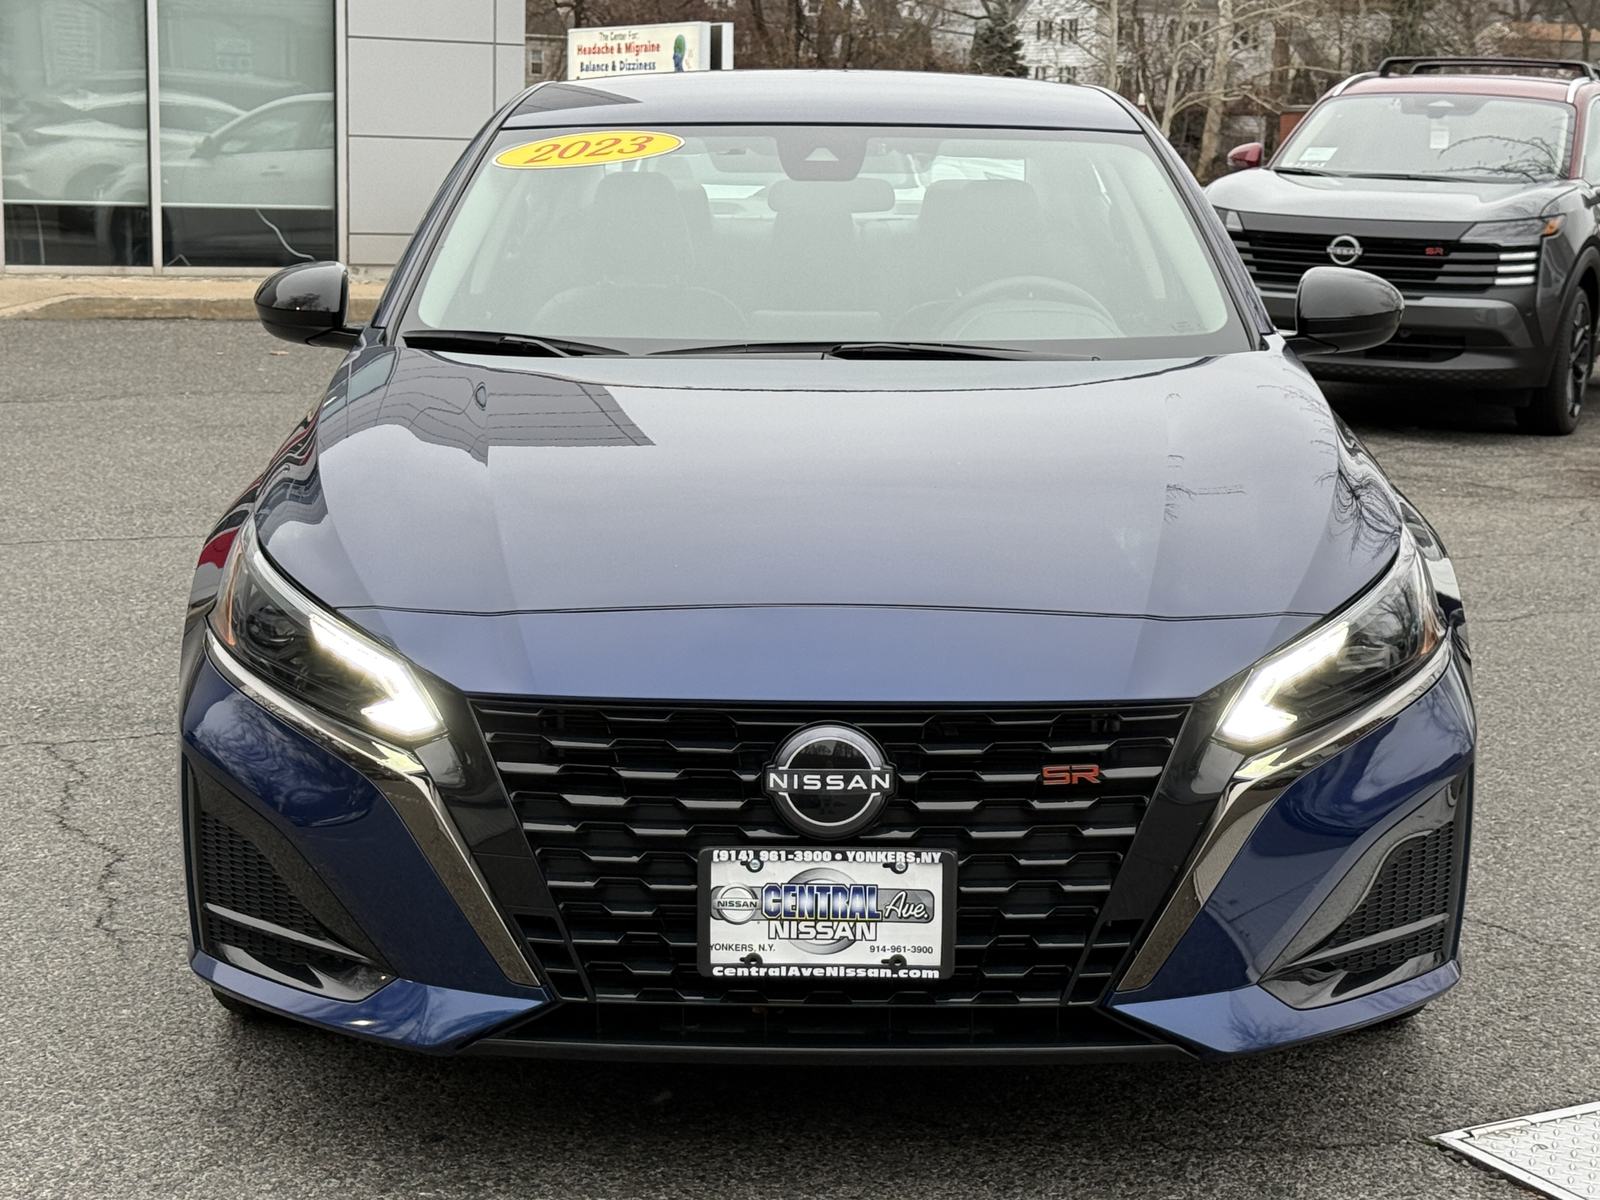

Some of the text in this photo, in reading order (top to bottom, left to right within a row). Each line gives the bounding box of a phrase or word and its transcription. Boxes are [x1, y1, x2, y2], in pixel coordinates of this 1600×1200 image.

[610, 31, 626, 41] Center
[577, 40, 661, 57] Headache & Migraine
[580, 58, 656, 72] Balance & Dizziness
[523, 136, 654, 164] 2023
[1425, 247, 1444, 255] SR
[1042, 764, 1101, 785] SR
[769, 773, 890, 790] NISSAN
[712, 850, 754, 862] (914)
[759, 850, 832, 861] 961-3900
[717, 900, 758, 908] NISSAN
[761, 883, 882, 921] CENTRAL
[768, 920, 877, 941] NISSAN
[758, 943, 776, 952] N.Y.
[869, 945, 933, 954] 914-961-3900
[712, 966, 940, 979] CentralAveNissan.com
